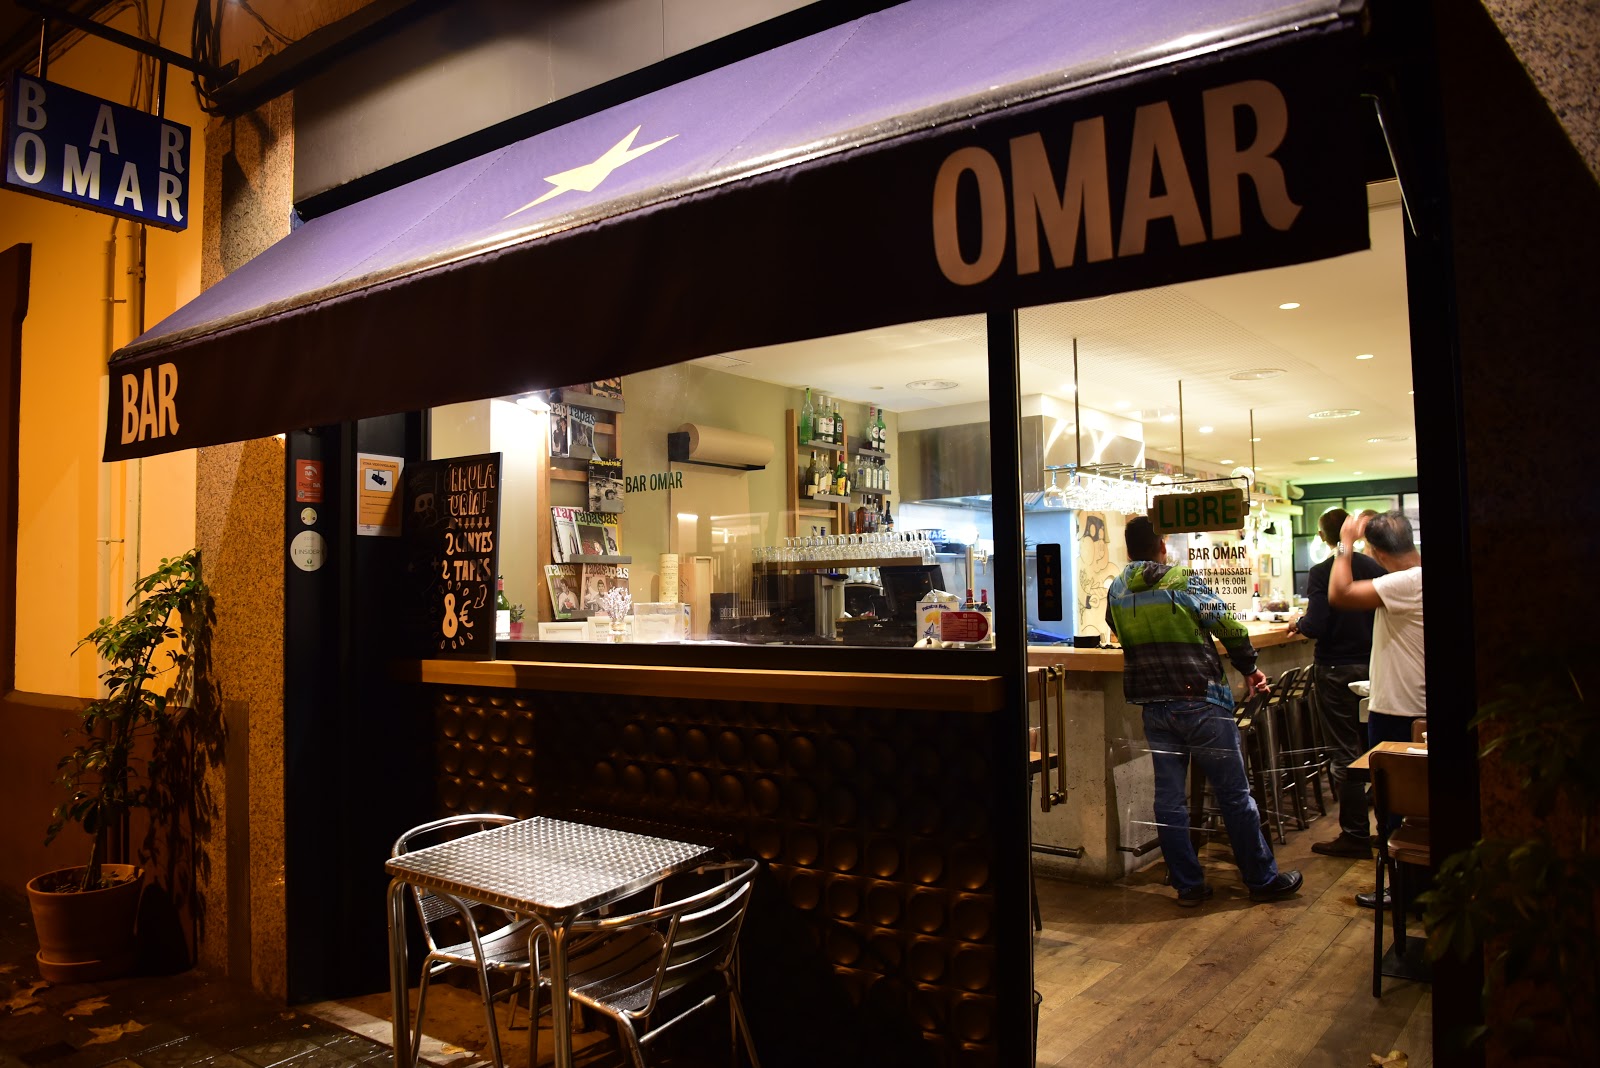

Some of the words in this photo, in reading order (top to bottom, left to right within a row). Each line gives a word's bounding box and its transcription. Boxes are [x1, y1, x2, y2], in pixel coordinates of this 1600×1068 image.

[17, 77, 185, 175] BAR
[14, 131, 184, 223] OMAR
[932, 79, 1302, 286] OMAR
[121, 362, 180, 445] BAR
[625, 475, 647, 493] BAR
[650, 471, 683, 491] OMAR
[1158, 494, 1237, 528] LIBRE
[444, 532, 454, 556] 2
[455, 531, 494, 553] CANYES
[1189, 547, 1210, 560] BAR
[1213, 546, 1245, 560] OMAR
[441, 559, 451, 580] 2
[453, 557, 491, 581] TAPES
[1182, 568, 1212, 577] DIMARTS
[1219, 567, 1253, 576] DISSABTE
[1214, 577, 1220, 585] A
[1222, 577, 1246, 585] 16.00H
[1215, 587, 1220, 595] A
[1222, 586, 1248, 595] 23.00H
[1199, 602, 1237, 611] DIUMENGE
[1223, 612, 1247, 621] 17.00H
